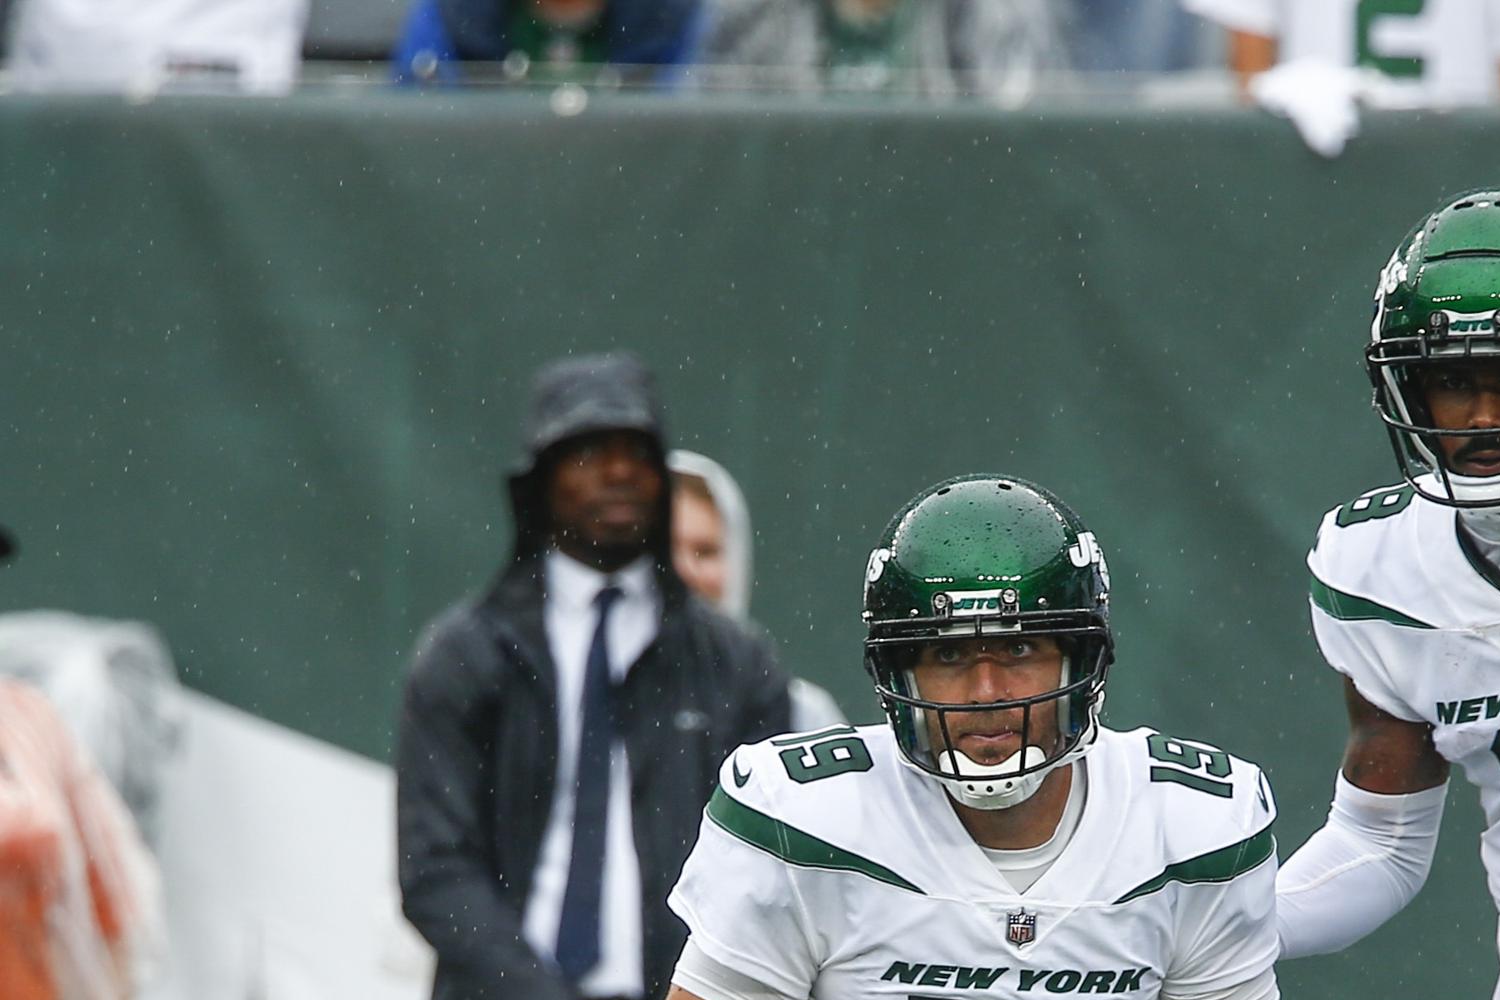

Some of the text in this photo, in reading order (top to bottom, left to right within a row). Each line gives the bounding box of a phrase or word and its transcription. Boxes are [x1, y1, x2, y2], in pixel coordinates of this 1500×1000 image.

[1335, 480, 1417, 528] 8
[770, 726, 875, 785] 19
[1146, 733, 1234, 799] 19
[880, 961, 1153, 994] NEW YORK
